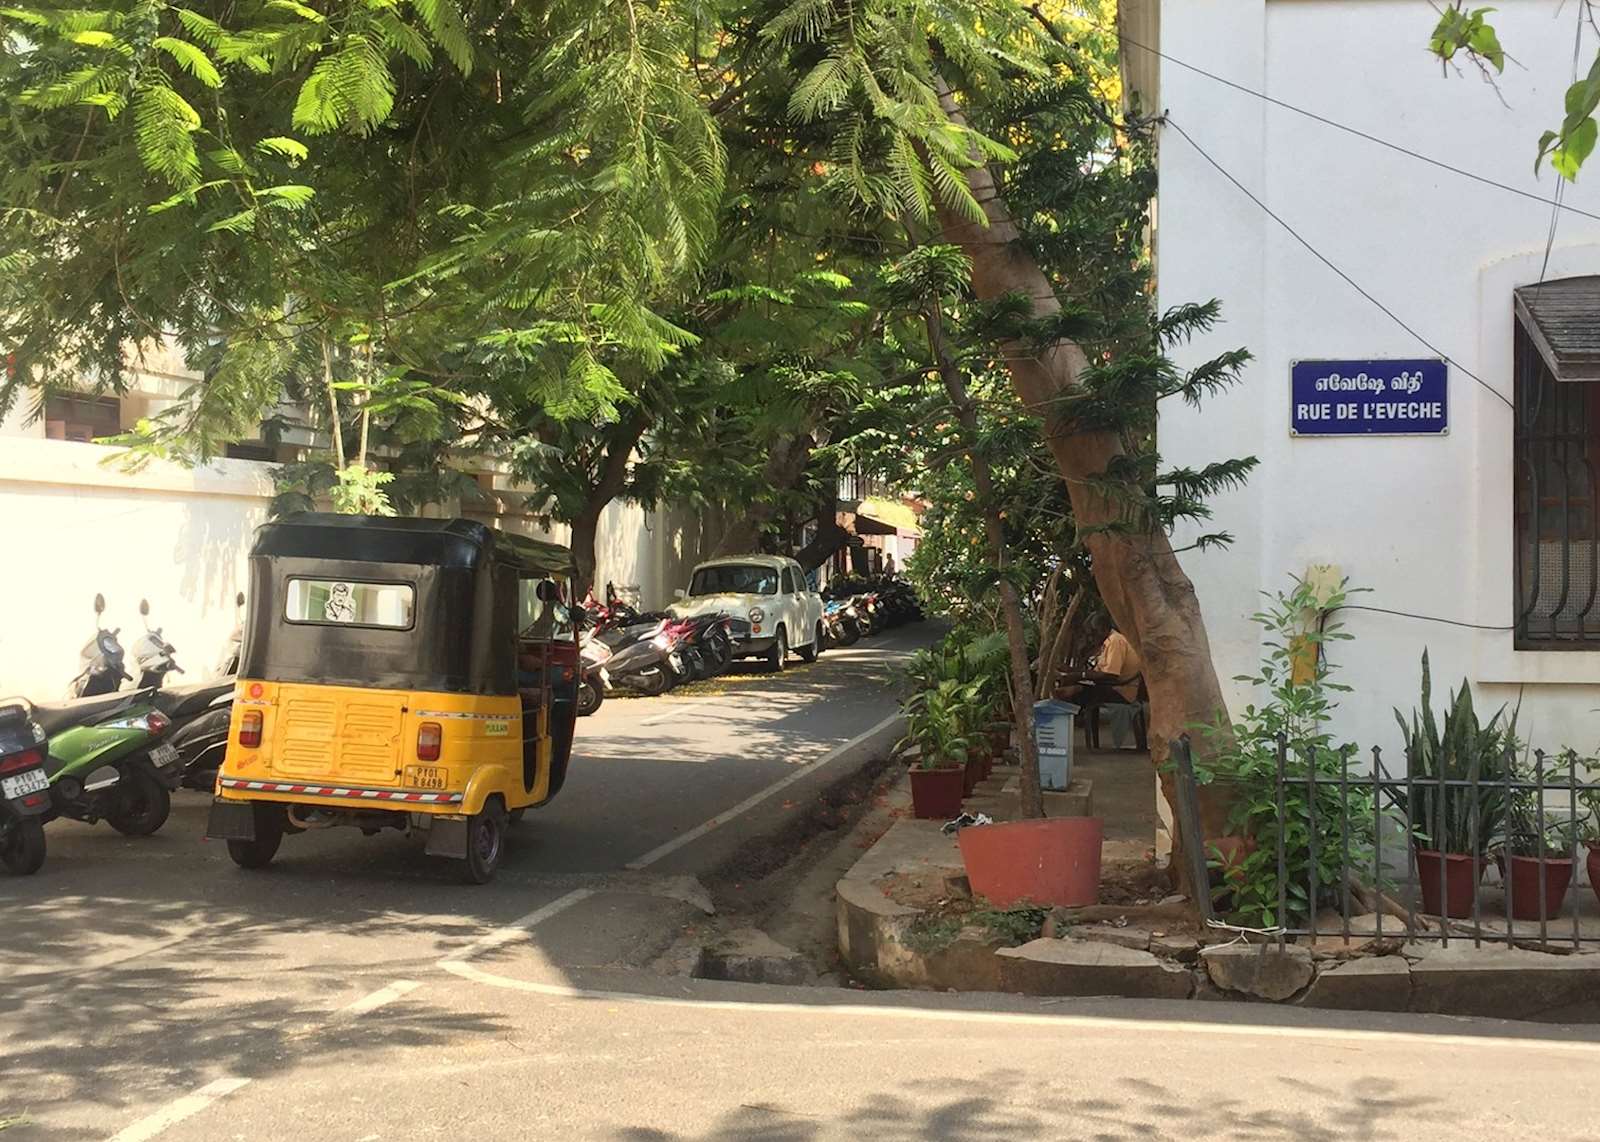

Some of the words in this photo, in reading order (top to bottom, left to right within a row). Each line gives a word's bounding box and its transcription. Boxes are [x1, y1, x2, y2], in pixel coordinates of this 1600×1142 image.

[1391, 371, 1423, 394] வீதி
[1297, 403, 1331, 420] RUE
[1336, 403, 1358, 420] DE
[1363, 402, 1442, 419] L'EVECHE
